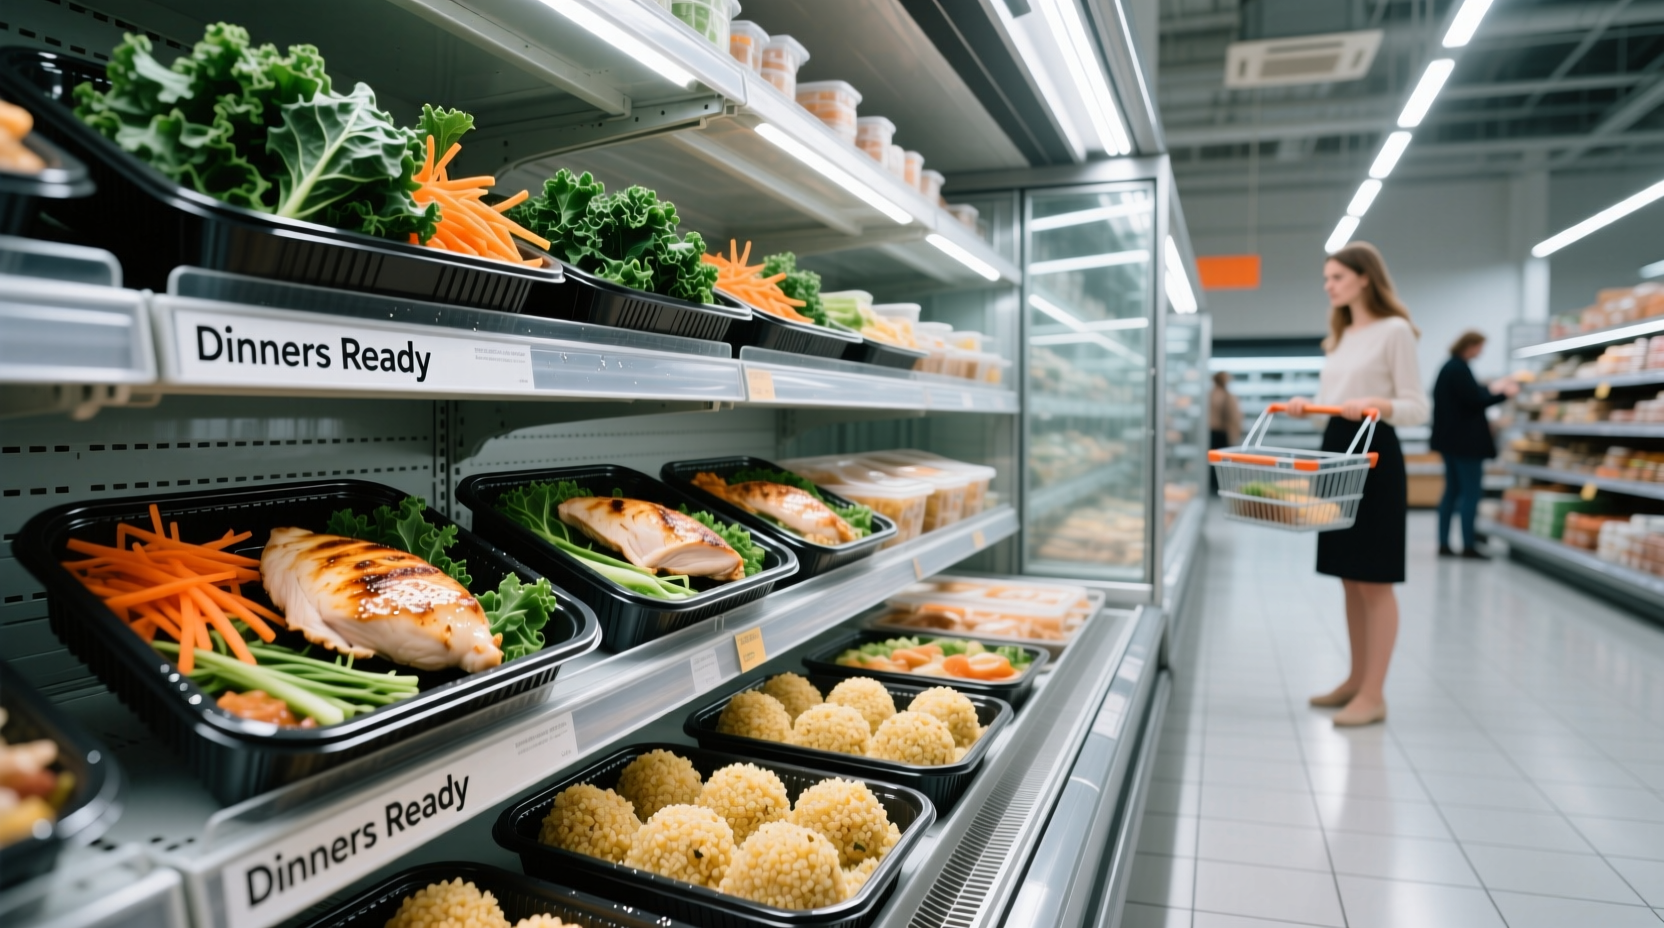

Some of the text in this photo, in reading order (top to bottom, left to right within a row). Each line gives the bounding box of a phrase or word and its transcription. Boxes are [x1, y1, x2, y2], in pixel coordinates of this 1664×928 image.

[196, 325, 431, 382] Dinners Ready
[246, 773, 469, 908] Dinners Ready
